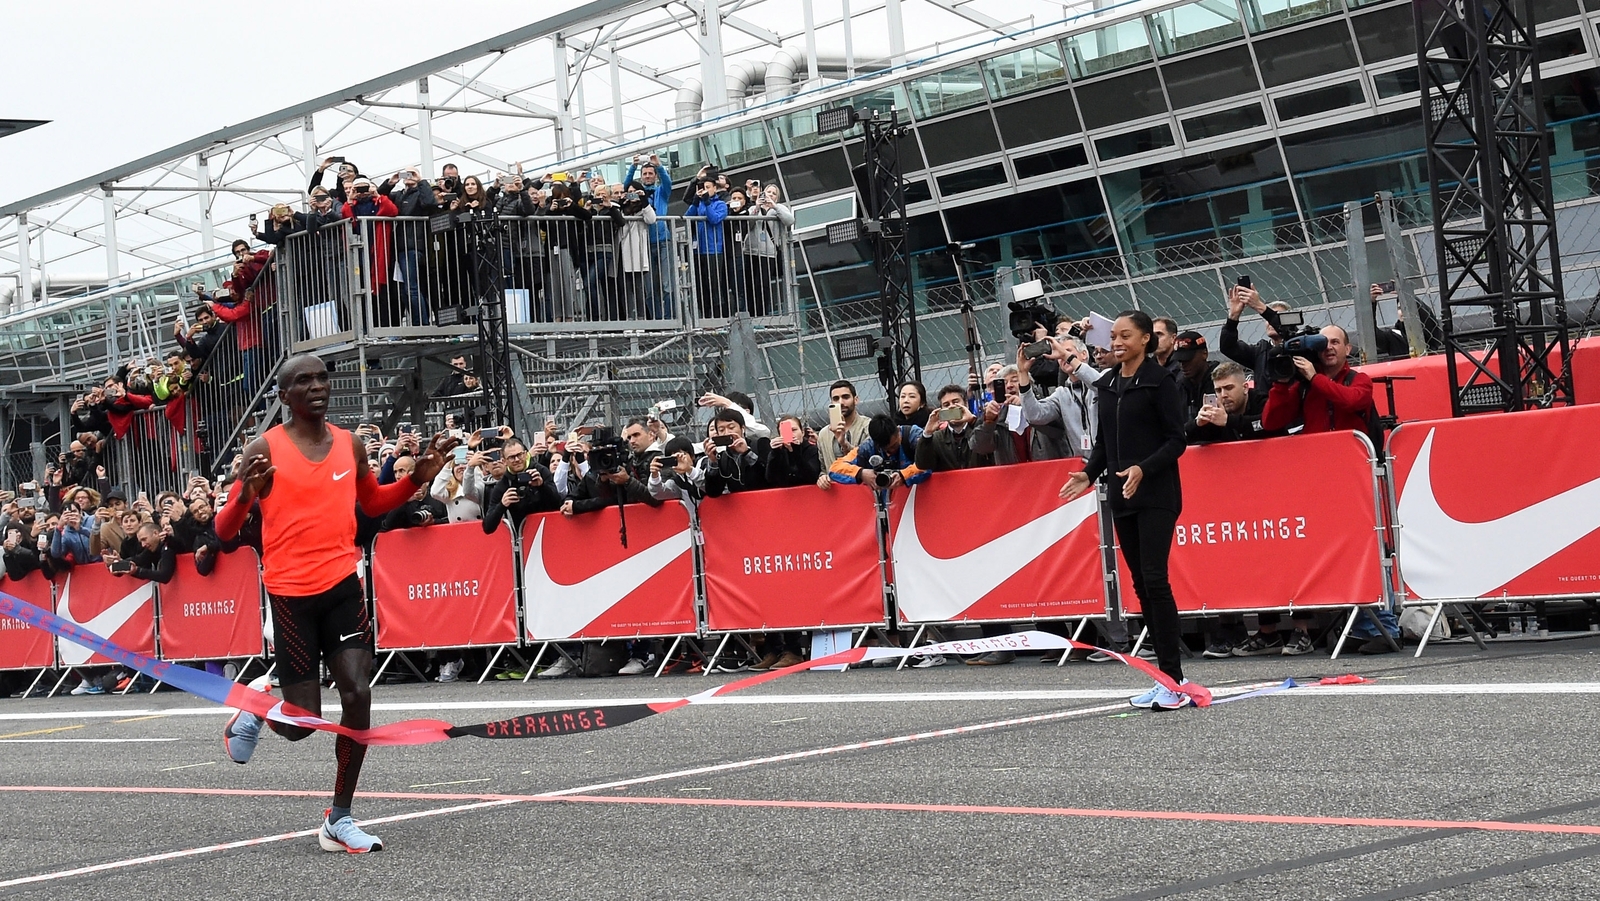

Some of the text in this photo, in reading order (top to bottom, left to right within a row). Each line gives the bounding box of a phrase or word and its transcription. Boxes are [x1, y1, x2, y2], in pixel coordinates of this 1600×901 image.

[1175, 517, 1306, 546] BREAKING2
[743, 551, 833, 575] BREAKING2
[408, 579, 479, 600] BREAKING2
[183, 600, 235, 617] BREAKING2
[486, 709, 607, 736] BREAKING2
